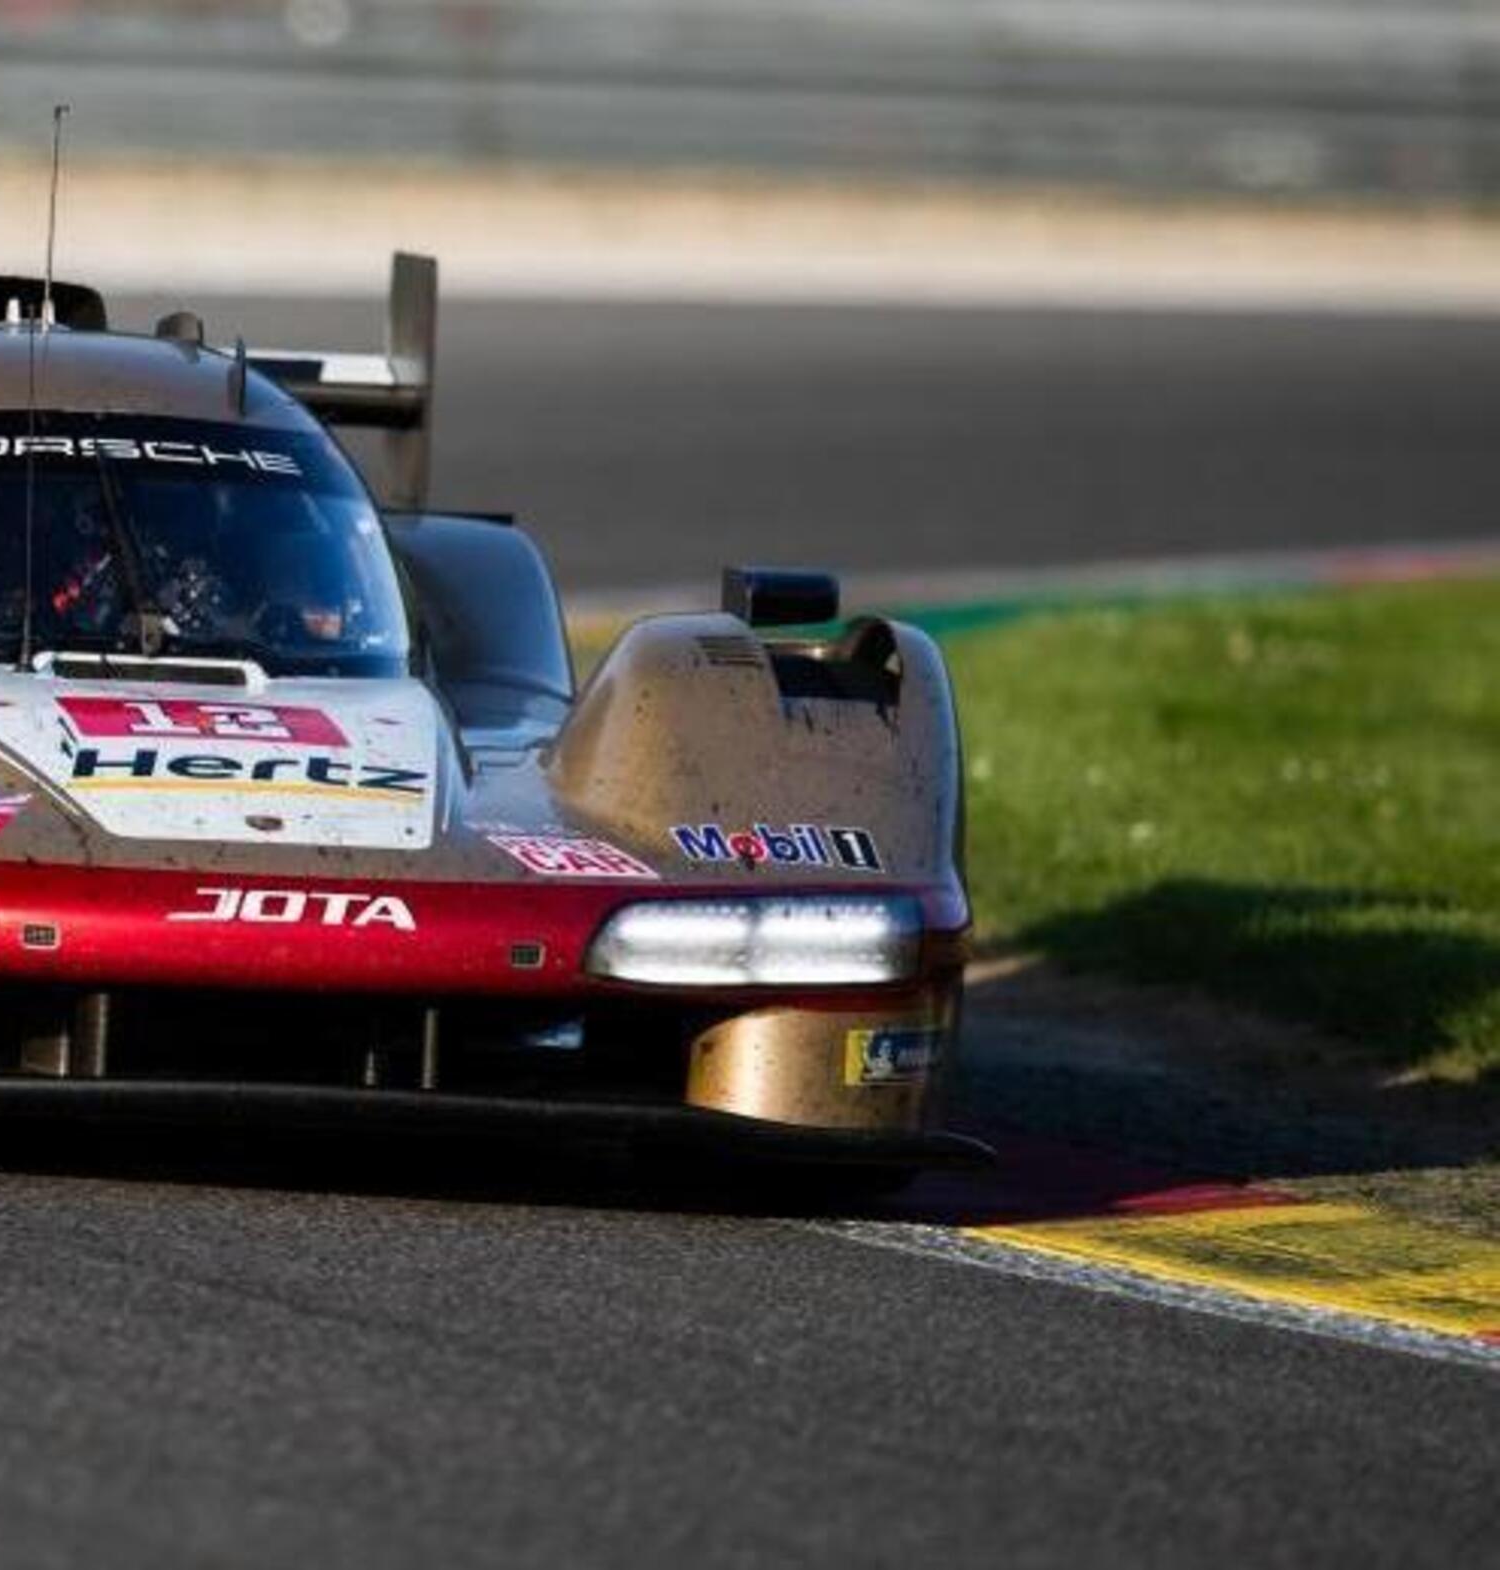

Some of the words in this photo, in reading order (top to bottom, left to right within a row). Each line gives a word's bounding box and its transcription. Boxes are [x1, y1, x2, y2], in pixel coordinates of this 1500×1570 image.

[124, 702, 293, 738] 12
[72, 747, 429, 794] Hertz
[674, 824, 829, 864] Mobil
[166, 886, 417, 931] JOTA
